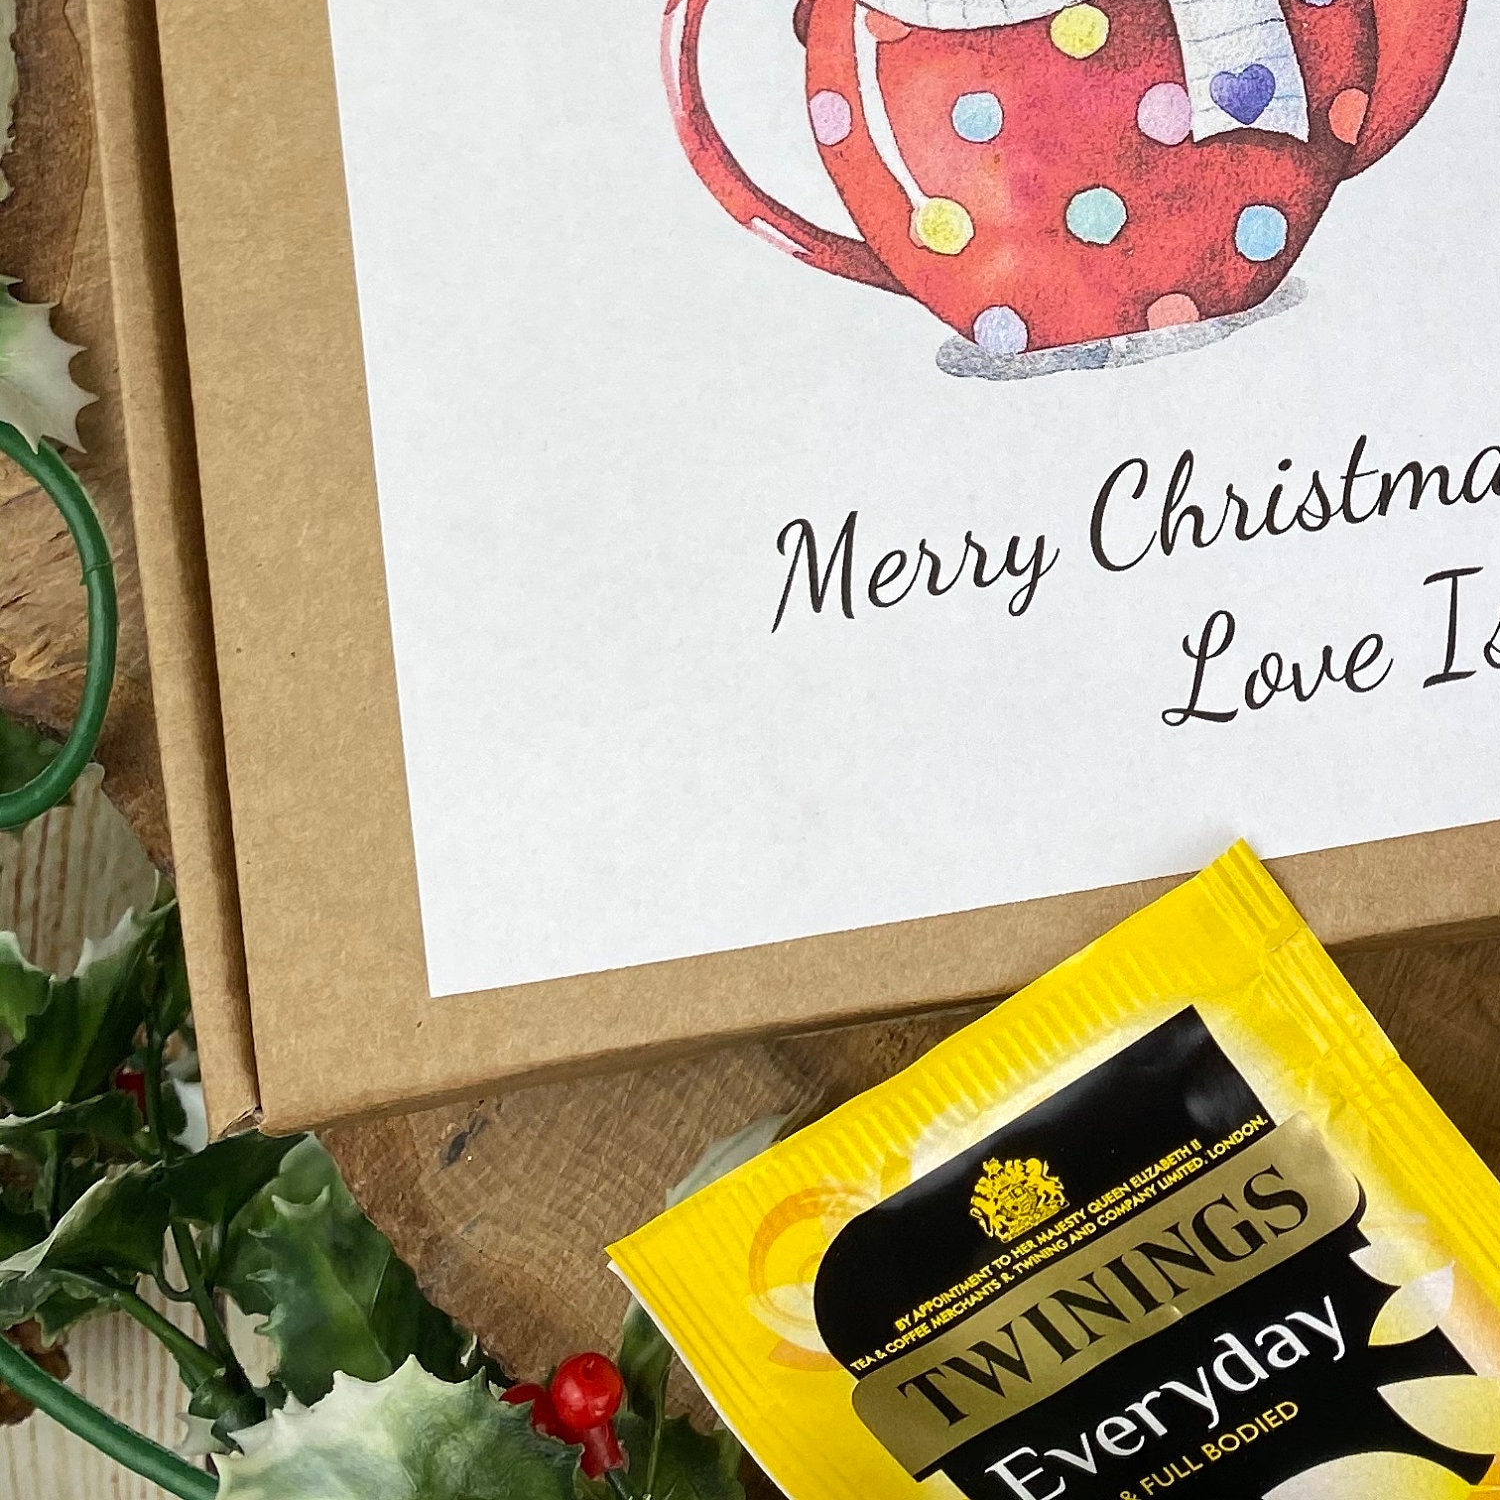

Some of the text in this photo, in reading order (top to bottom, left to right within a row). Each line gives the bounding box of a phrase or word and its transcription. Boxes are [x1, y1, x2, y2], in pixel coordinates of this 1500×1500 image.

[771, 511, 1060, 633] Merry
[1161, 610, 1394, 727] Love
[850, 1355, 878, 1371] TEA
[874, 1349, 888, 1360] &
[885, 1322, 932, 1354] COFFEE
[933, 1280, 1002, 1329] MERCHANTS
[1013, 1238, 1069, 1275] TWINING
[1069, 1222, 1097, 1246] AND
[1096, 1185, 1158, 1227] COMPANY
[1207, 1114, 1269, 1160] LONDON.
[894, 1138, 1203, 1332] BY APPOINTMENT TO HER MAJESTY QUEEN ELIZABETH II
[896, 1164, 1308, 1428] TWININGS
[984, 1295, 1345, 1500] Everyday
[1140, 1455, 1203, 1496] FULL
[1201, 1401, 1300, 1461] BODIED
